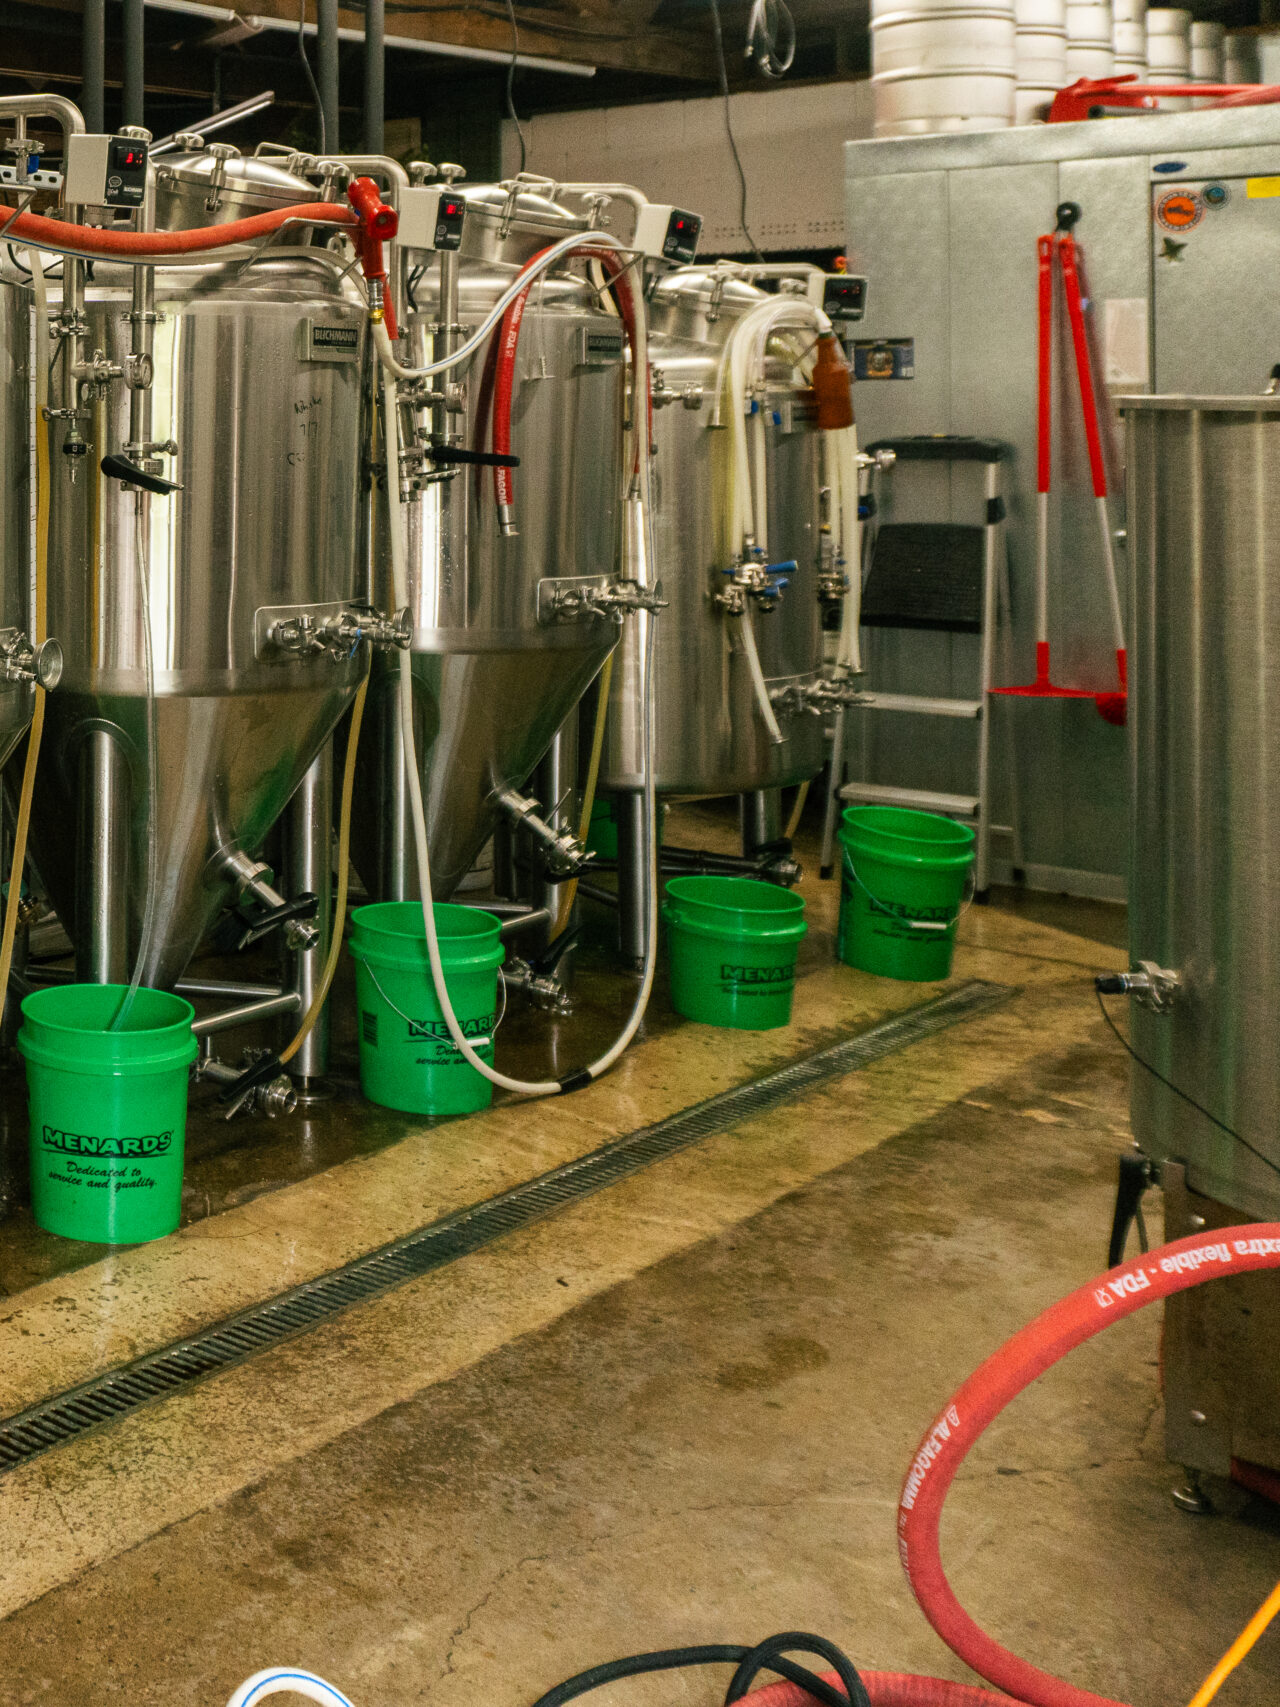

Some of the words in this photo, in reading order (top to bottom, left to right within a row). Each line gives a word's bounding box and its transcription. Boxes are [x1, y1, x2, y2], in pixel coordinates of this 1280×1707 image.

[314, 328, 358, 342] BLICHMANN
[42, 1124, 172, 1156] MENARDS
[48, 1170, 83, 1186] service
[87, 1179, 111, 1189] and
[66, 1160, 128, 1178] Dedicated
[131, 1167, 142, 1178] to
[1159, 1242, 1233, 1274] flexible
[1107, 1268, 1152, 1298] FDA
[901, 1416, 952, 1510] ALFAGOMMA
